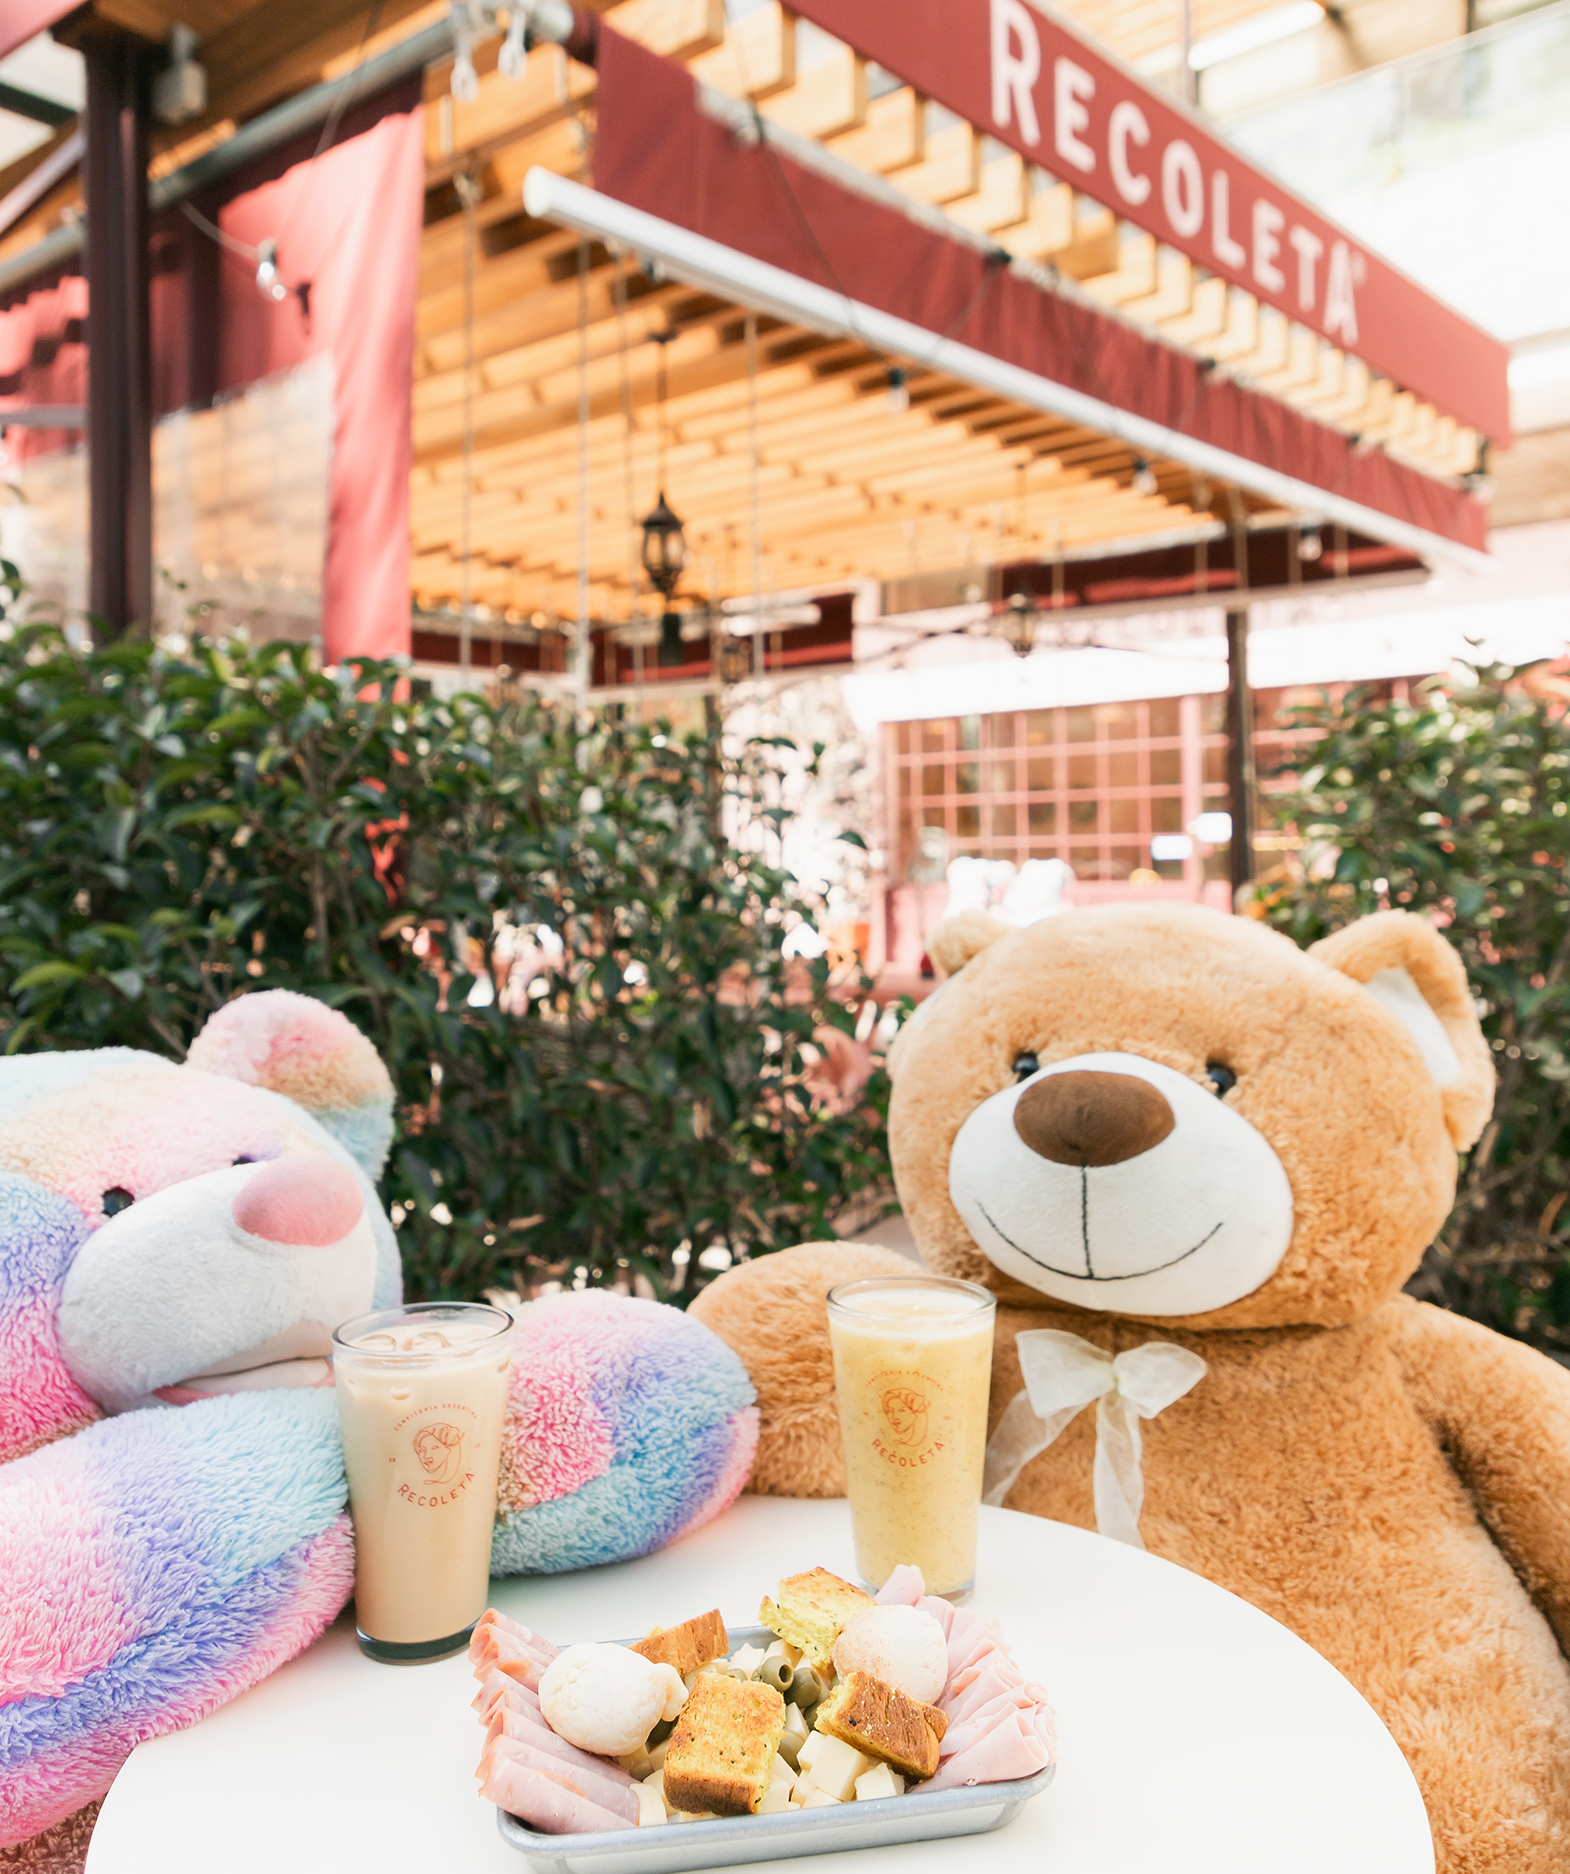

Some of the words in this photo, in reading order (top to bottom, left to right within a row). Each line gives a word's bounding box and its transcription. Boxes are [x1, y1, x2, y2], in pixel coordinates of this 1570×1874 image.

[990, 0, 1358, 346] RECOLETA
[871, 1438, 945, 1467] RECOLETA
[397, 1472, 475, 1507] RECOLETA
